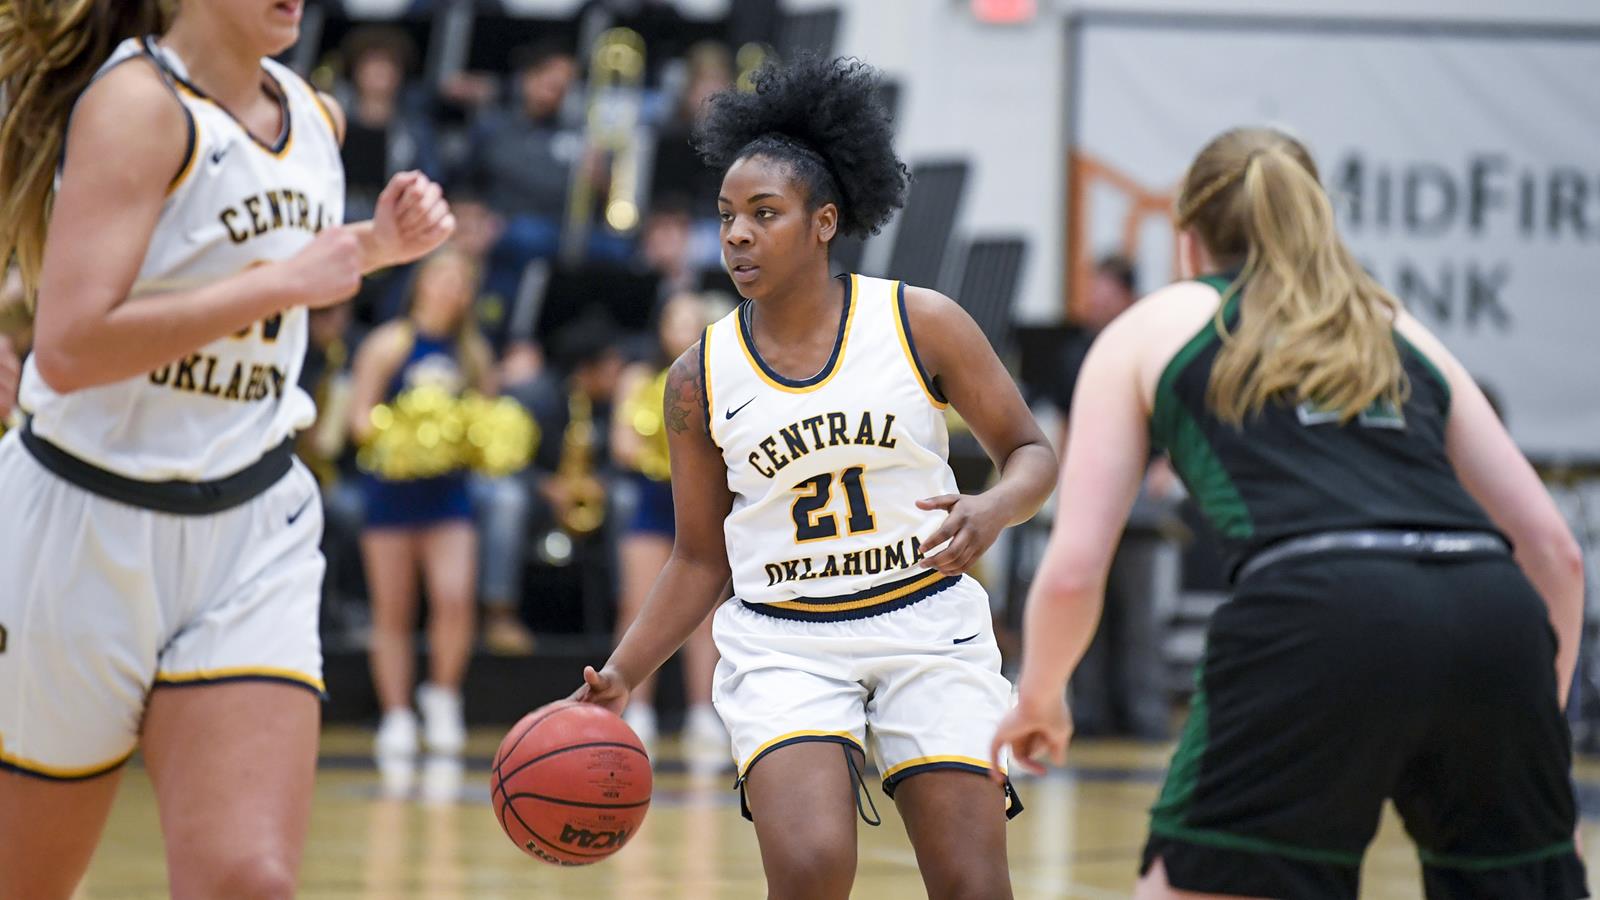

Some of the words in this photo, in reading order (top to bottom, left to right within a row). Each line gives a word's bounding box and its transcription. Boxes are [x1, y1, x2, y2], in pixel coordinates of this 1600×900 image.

[1332, 150, 1600, 241] IDFIR
[748, 411, 897, 479] CENTRAL
[789, 464, 878, 545] 21
[764, 536, 926, 587] OKLAHOMA
[558, 823, 633, 849] NCAA
